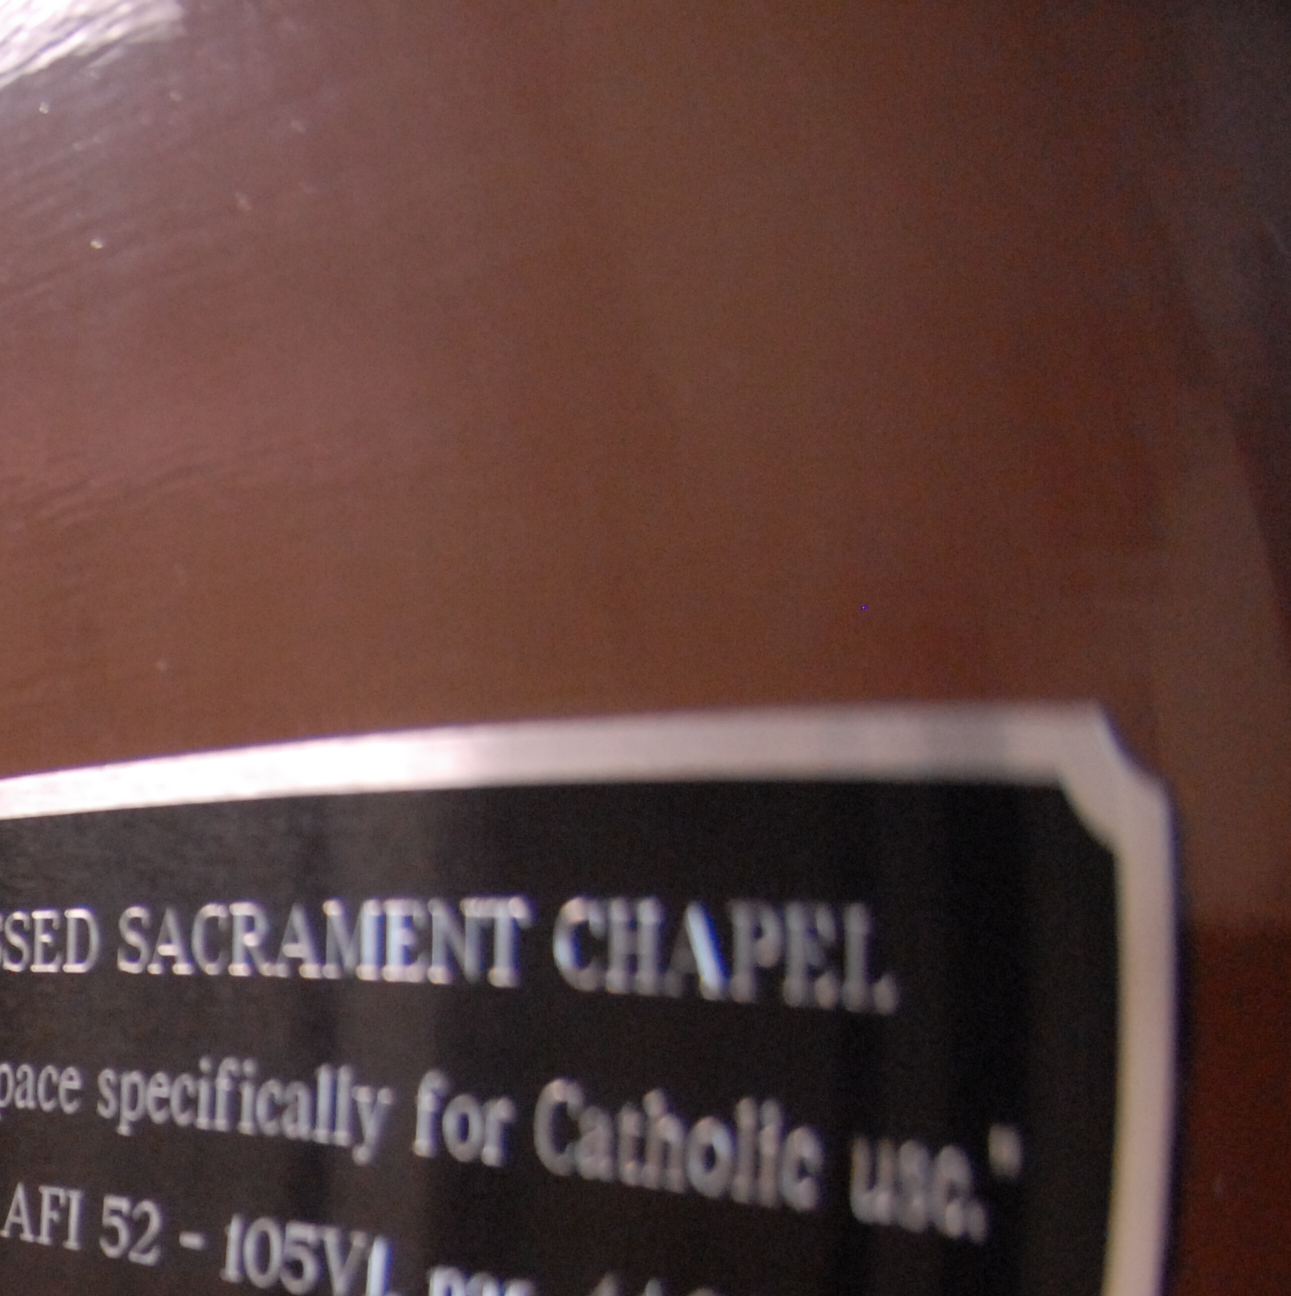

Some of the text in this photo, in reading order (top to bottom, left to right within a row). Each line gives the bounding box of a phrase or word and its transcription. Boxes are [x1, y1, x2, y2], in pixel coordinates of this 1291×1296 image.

[117, 898, 533, 987] SACRAMENT
[552, 896, 897, 1015] CHAPEL
[96, 1056, 393, 1165] specifically
[414, 1069, 515, 1166] for
[534, 1077, 822, 1211] Catholic
[0, 1182, 83, 1250] AFI
[99, 1194, 163, 1266] 52
